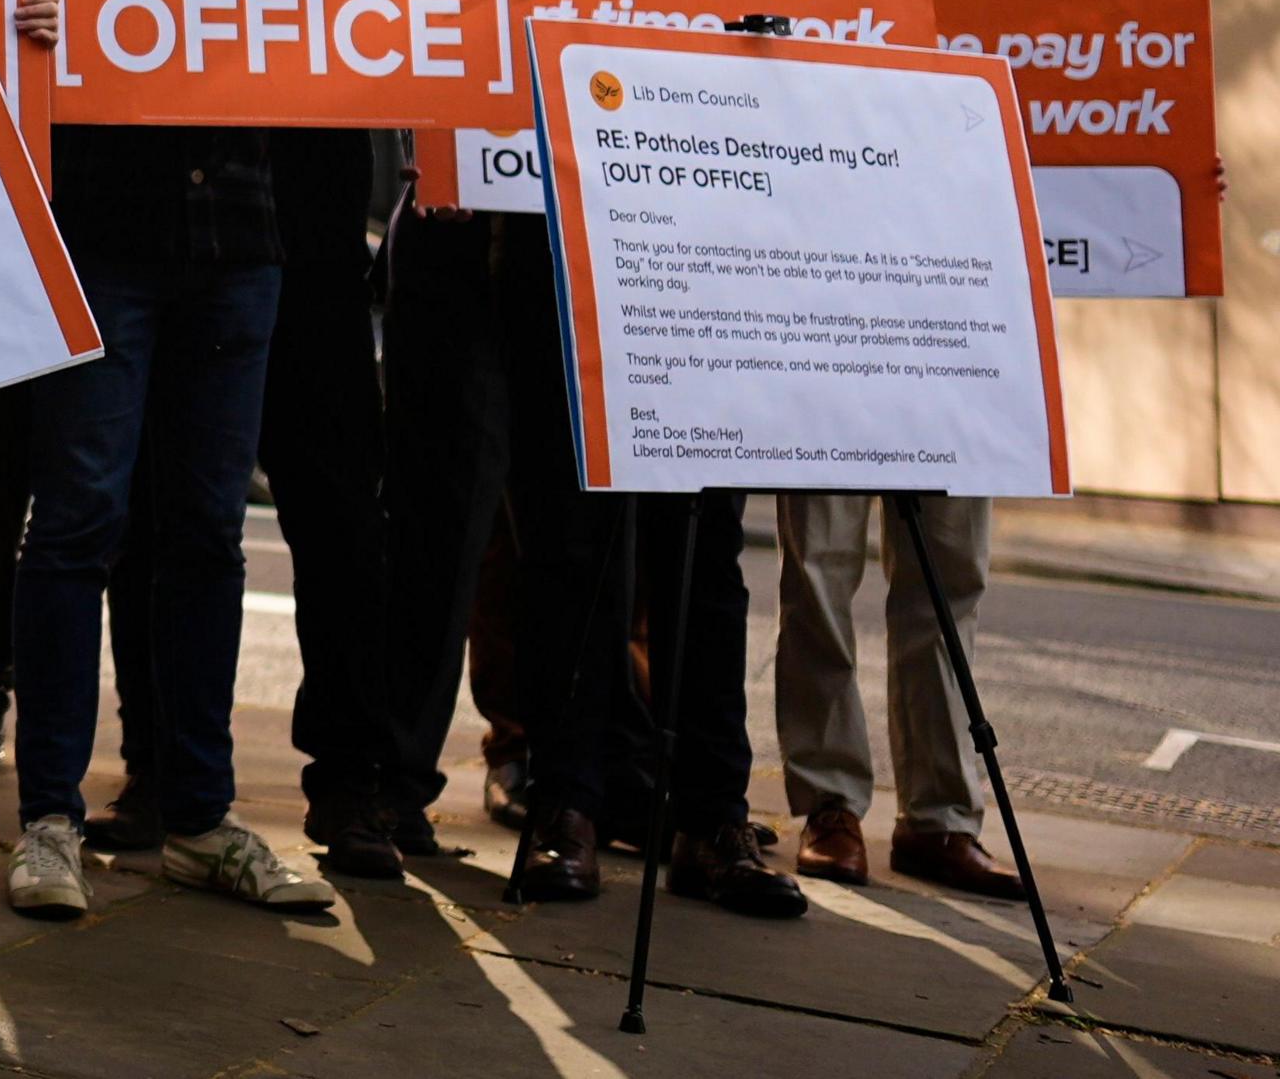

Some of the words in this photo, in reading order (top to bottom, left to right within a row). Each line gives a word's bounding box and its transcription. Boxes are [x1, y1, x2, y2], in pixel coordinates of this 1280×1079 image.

[999, 33, 1104, 80] pay
[1115, 21, 1194, 68] for
[631, 84, 657, 103] Lib
[657, 85, 695, 105] Dem
[696, 88, 761, 110] Councils
[1028, 88, 1176, 135] work
[594, 127, 632, 151] RE:
[633, 129, 721, 157] Potholes
[723, 135, 825, 167] Destroyed
[828, 147, 859, 171] my
[860, 145, 901, 169] Car!
[600, 160, 653, 188] [OUT
[657, 164, 688, 187] OF
[691, 166, 774, 198] OFFICE]
[607, 207, 638, 224] Dear
[638, 209, 678, 228] Oliver,
[629, 405, 661, 424] Best,
[630, 424, 662, 441] Jane
[661, 425, 689, 441] Doe
[688, 425, 745, 445] (She/Her)
[631, 442, 676, 460] Liberal
[674, 443, 734, 461] Democrat
[733, 444, 795, 462] Controlled
[794, 446, 830, 462] South
[829, 446, 917, 467] Cambridgeshire
[916, 448, 958, 465] Council
